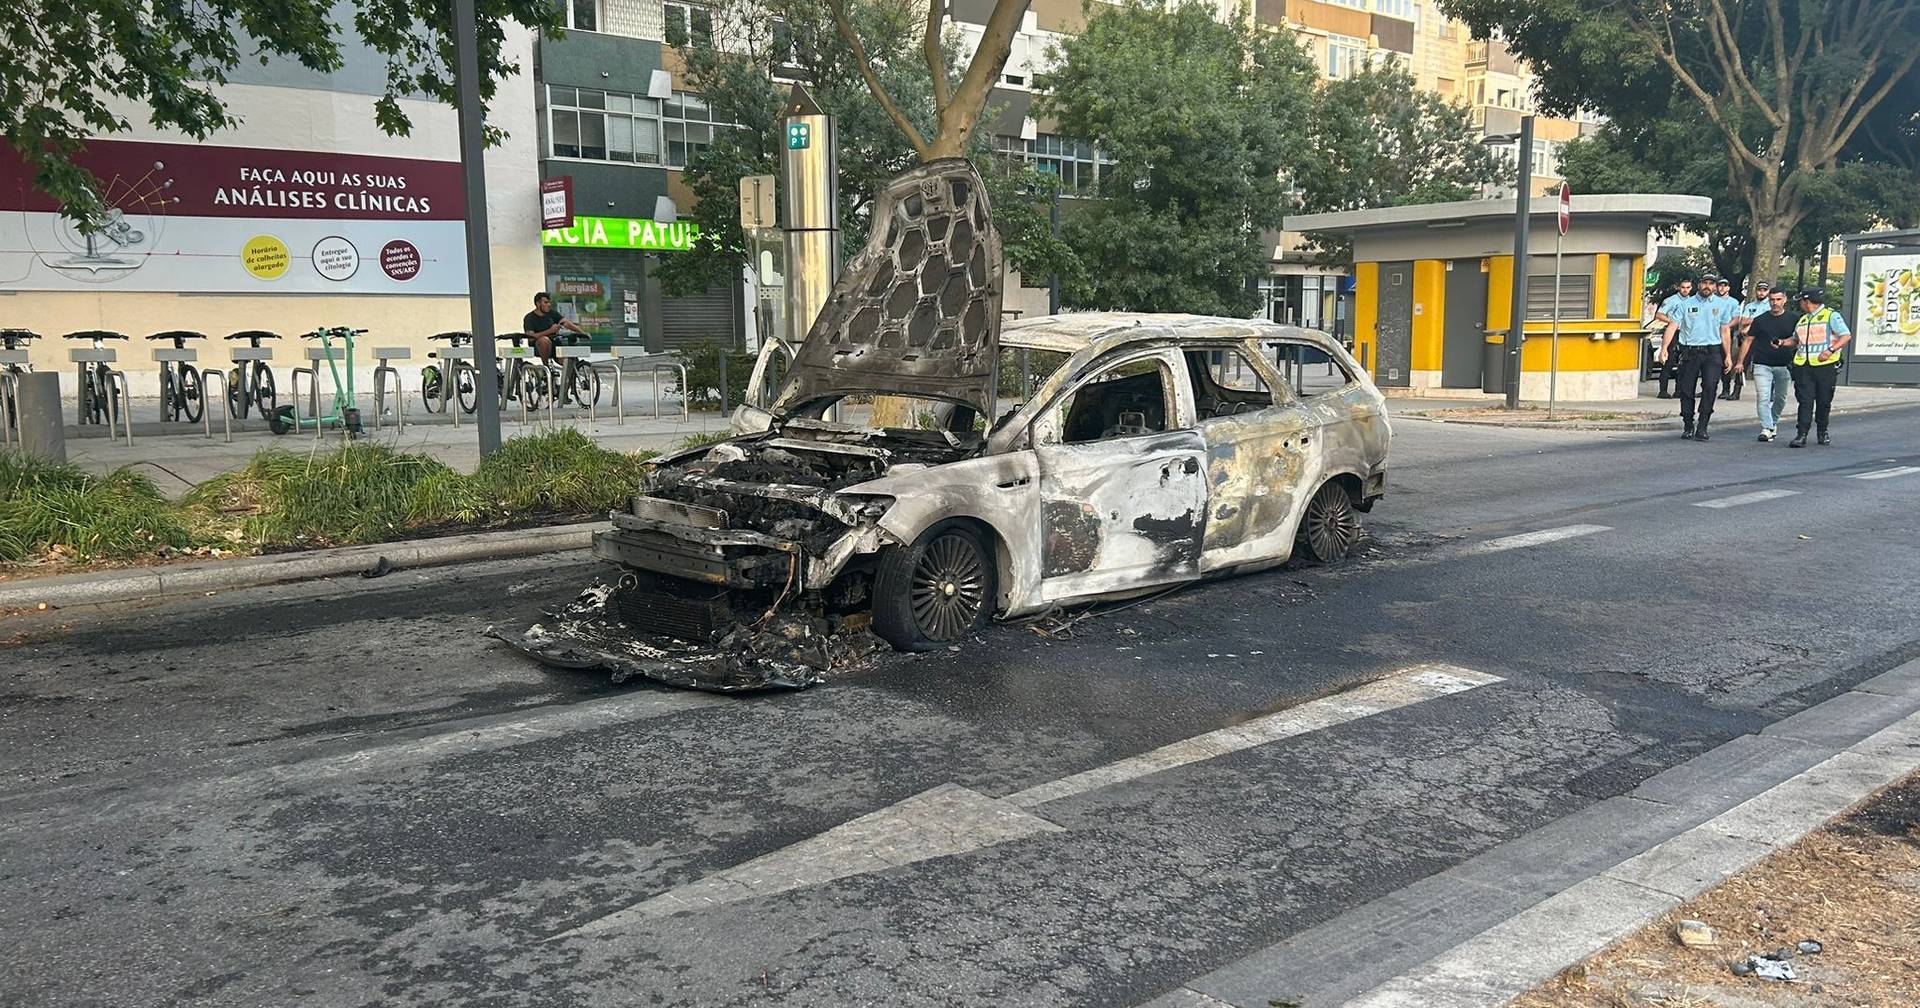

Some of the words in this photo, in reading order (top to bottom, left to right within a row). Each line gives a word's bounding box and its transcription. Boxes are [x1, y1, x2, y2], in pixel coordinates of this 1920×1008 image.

[240, 167, 286, 184] FAÇA
[291, 170, 335, 187] AQUI
[341, 173, 361, 187] AS
[367, 174, 407, 189] SUAS
[214, 185, 327, 209] ANÁLISES
[334, 190, 431, 214] CLÍNICAS
[251, 246, 278, 255] Horário
[321, 248, 348, 257] Entregue
[386, 247, 403, 255] Todos
[256, 253, 287, 263] colheitas
[320, 256, 335, 265] aqui
[386, 254, 409, 263] acordos
[253, 261, 285, 272] alargado
[325, 262, 352, 271] citologia
[385, 260, 418, 270] convenções
[1885, 269, 1900, 333] PEDRAS
